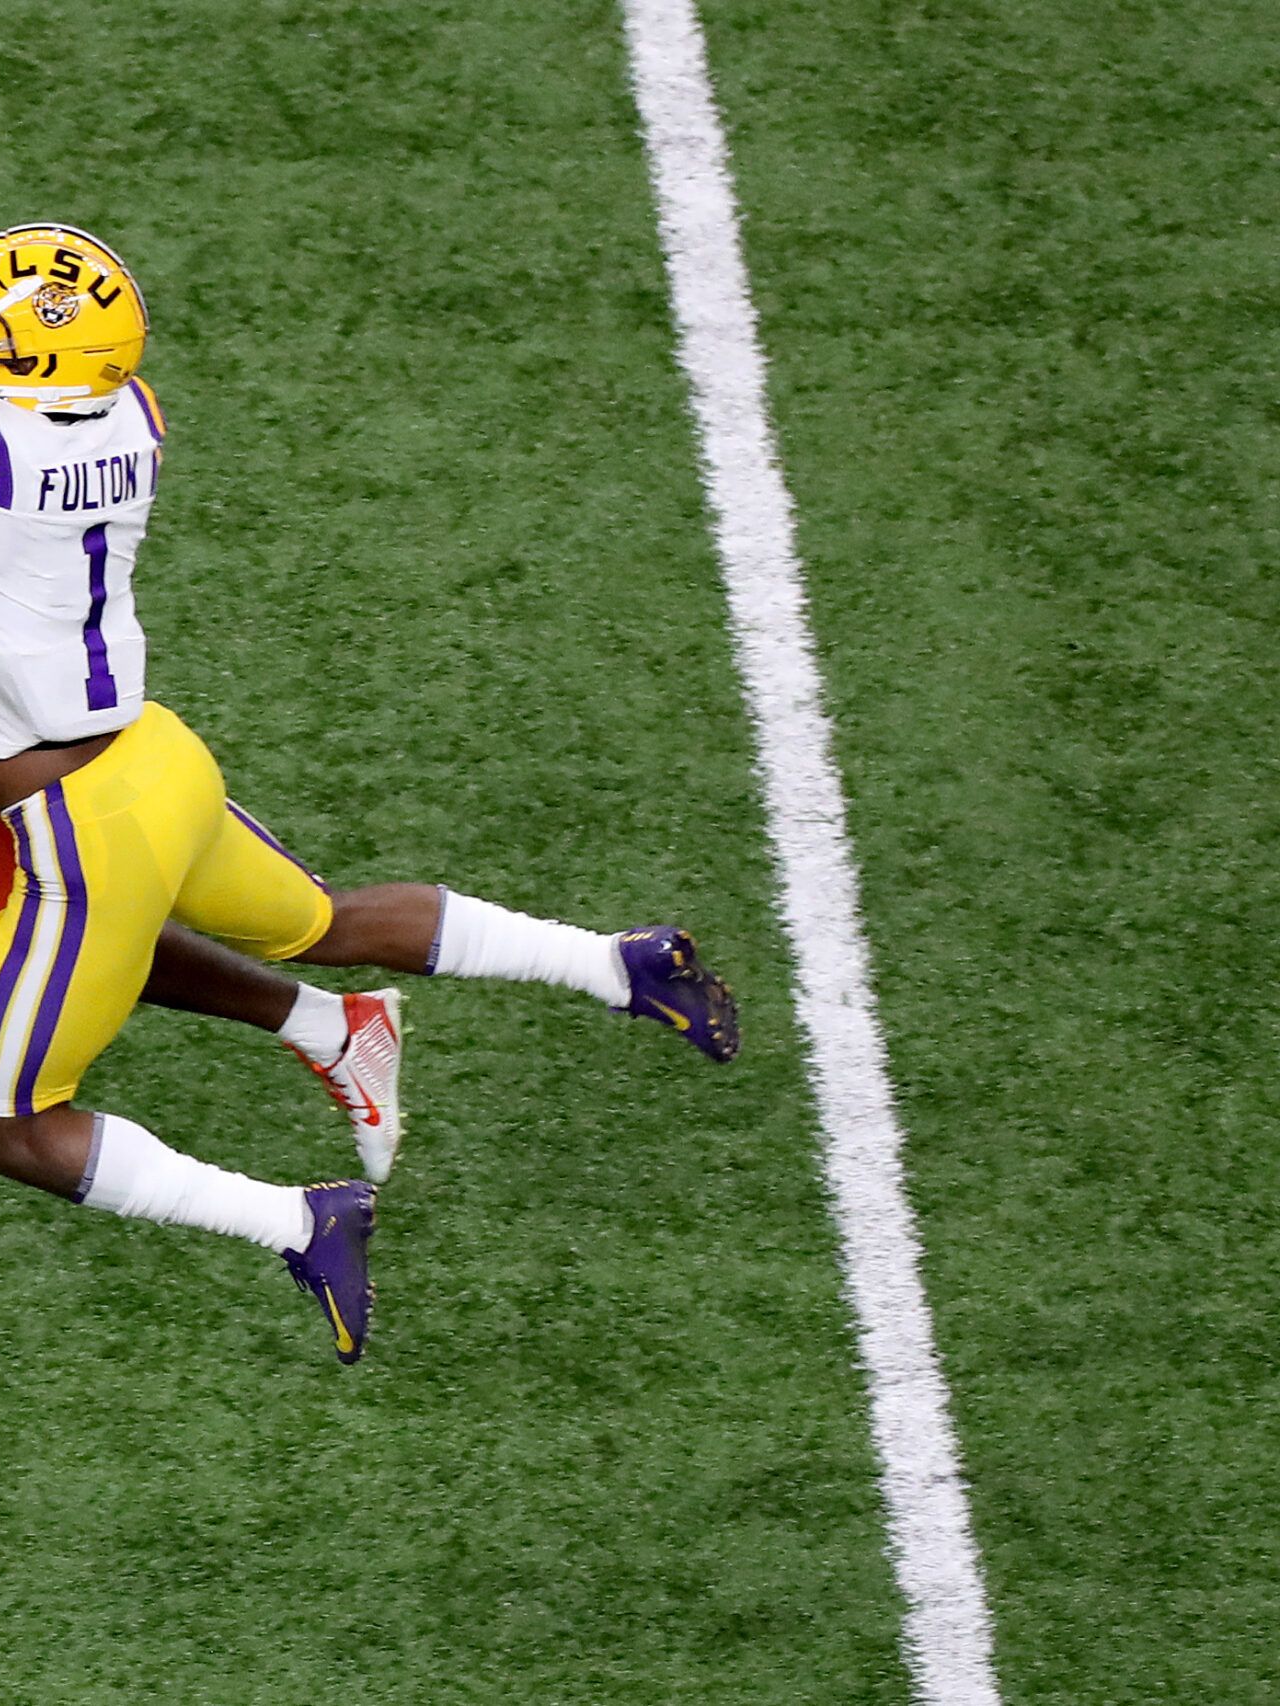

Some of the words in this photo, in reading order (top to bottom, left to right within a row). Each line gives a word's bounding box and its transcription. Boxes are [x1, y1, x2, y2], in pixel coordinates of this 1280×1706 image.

[10, 249, 122, 309] LSU
[38, 451, 138, 511] FULTON
[82, 521, 118, 712] 1
